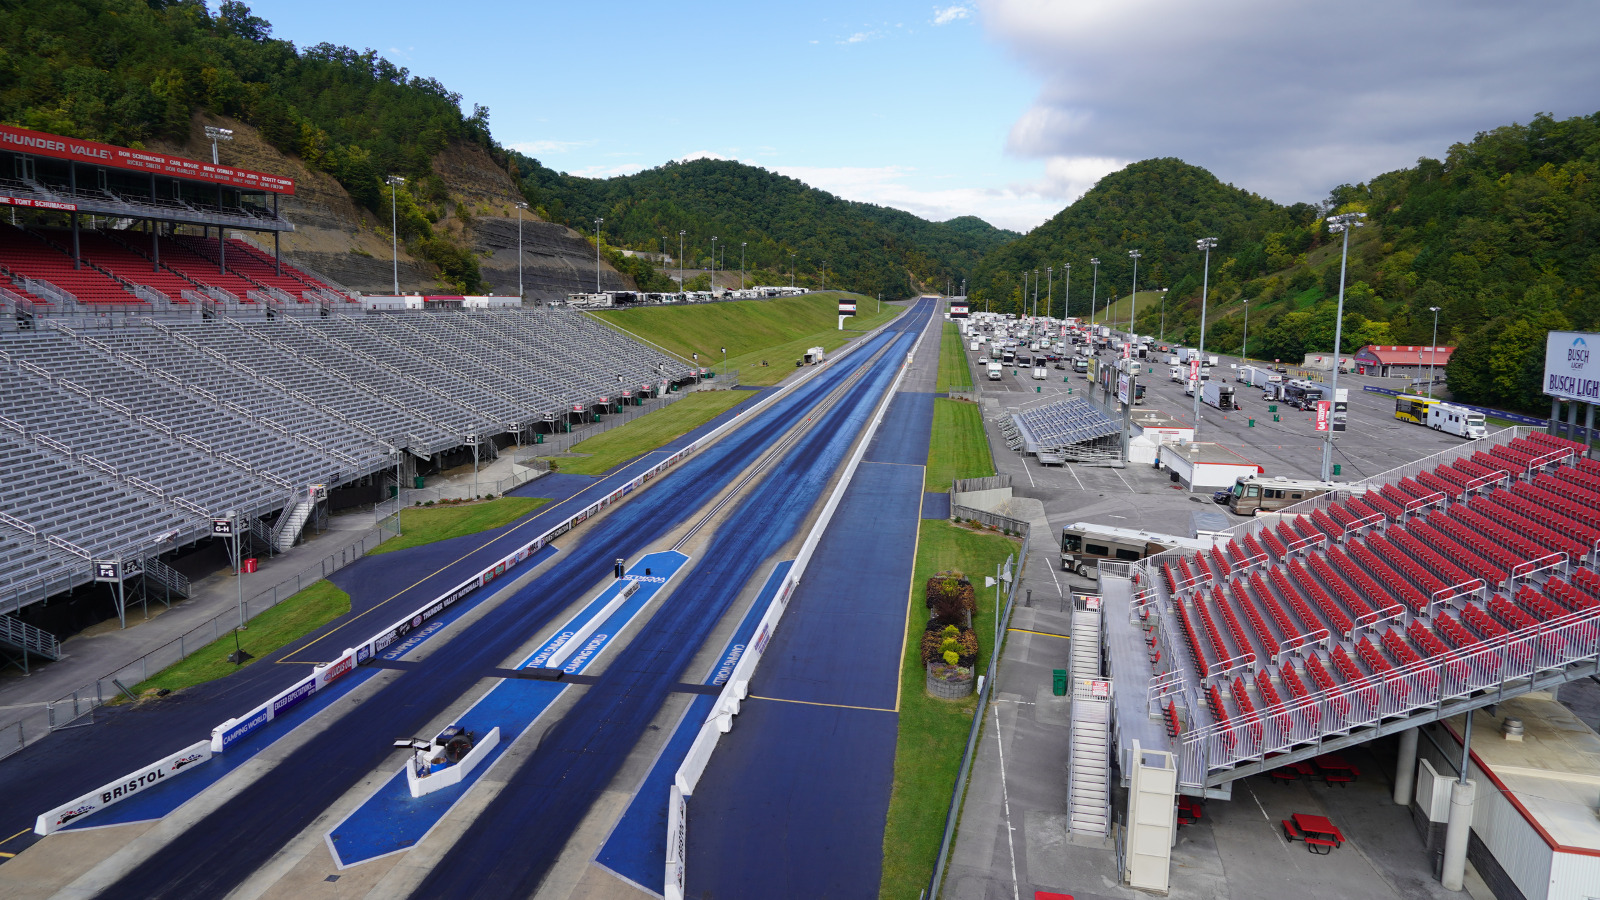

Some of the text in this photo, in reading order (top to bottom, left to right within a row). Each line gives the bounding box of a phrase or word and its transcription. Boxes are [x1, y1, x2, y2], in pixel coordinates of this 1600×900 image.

[132, 153, 165, 163] SCHUMACHER
[14, 198, 32, 206] TONY
[34, 200, 76, 211] SCHUMACHER
[1567, 348, 1589, 363] BUSCH
[1549, 374, 1600, 398] BUSCH LIGH
[1317, 421, 1326, 430] 3
[100, 569, 114, 577] F-G
[422, 602, 443, 621] THUNDER
[443, 592, 458, 608] VALLEY
[457, 579, 480, 599] NATIONALS
[382, 636, 422, 660] CAMPING
[417, 621, 444, 639] WORLD
[545, 631, 574, 653] CAMPING
[563, 633, 608, 674] CAMPING WORLD
[712, 644, 745, 685] CAMPING WORLD
[331, 664, 346, 679] LUCAS
[344, 659, 352, 670] OIL
[274, 694, 288, 712] EXCEED
[223, 711, 268, 745] CAMPING WORLD
[102, 768, 166, 805] BRISTOL
